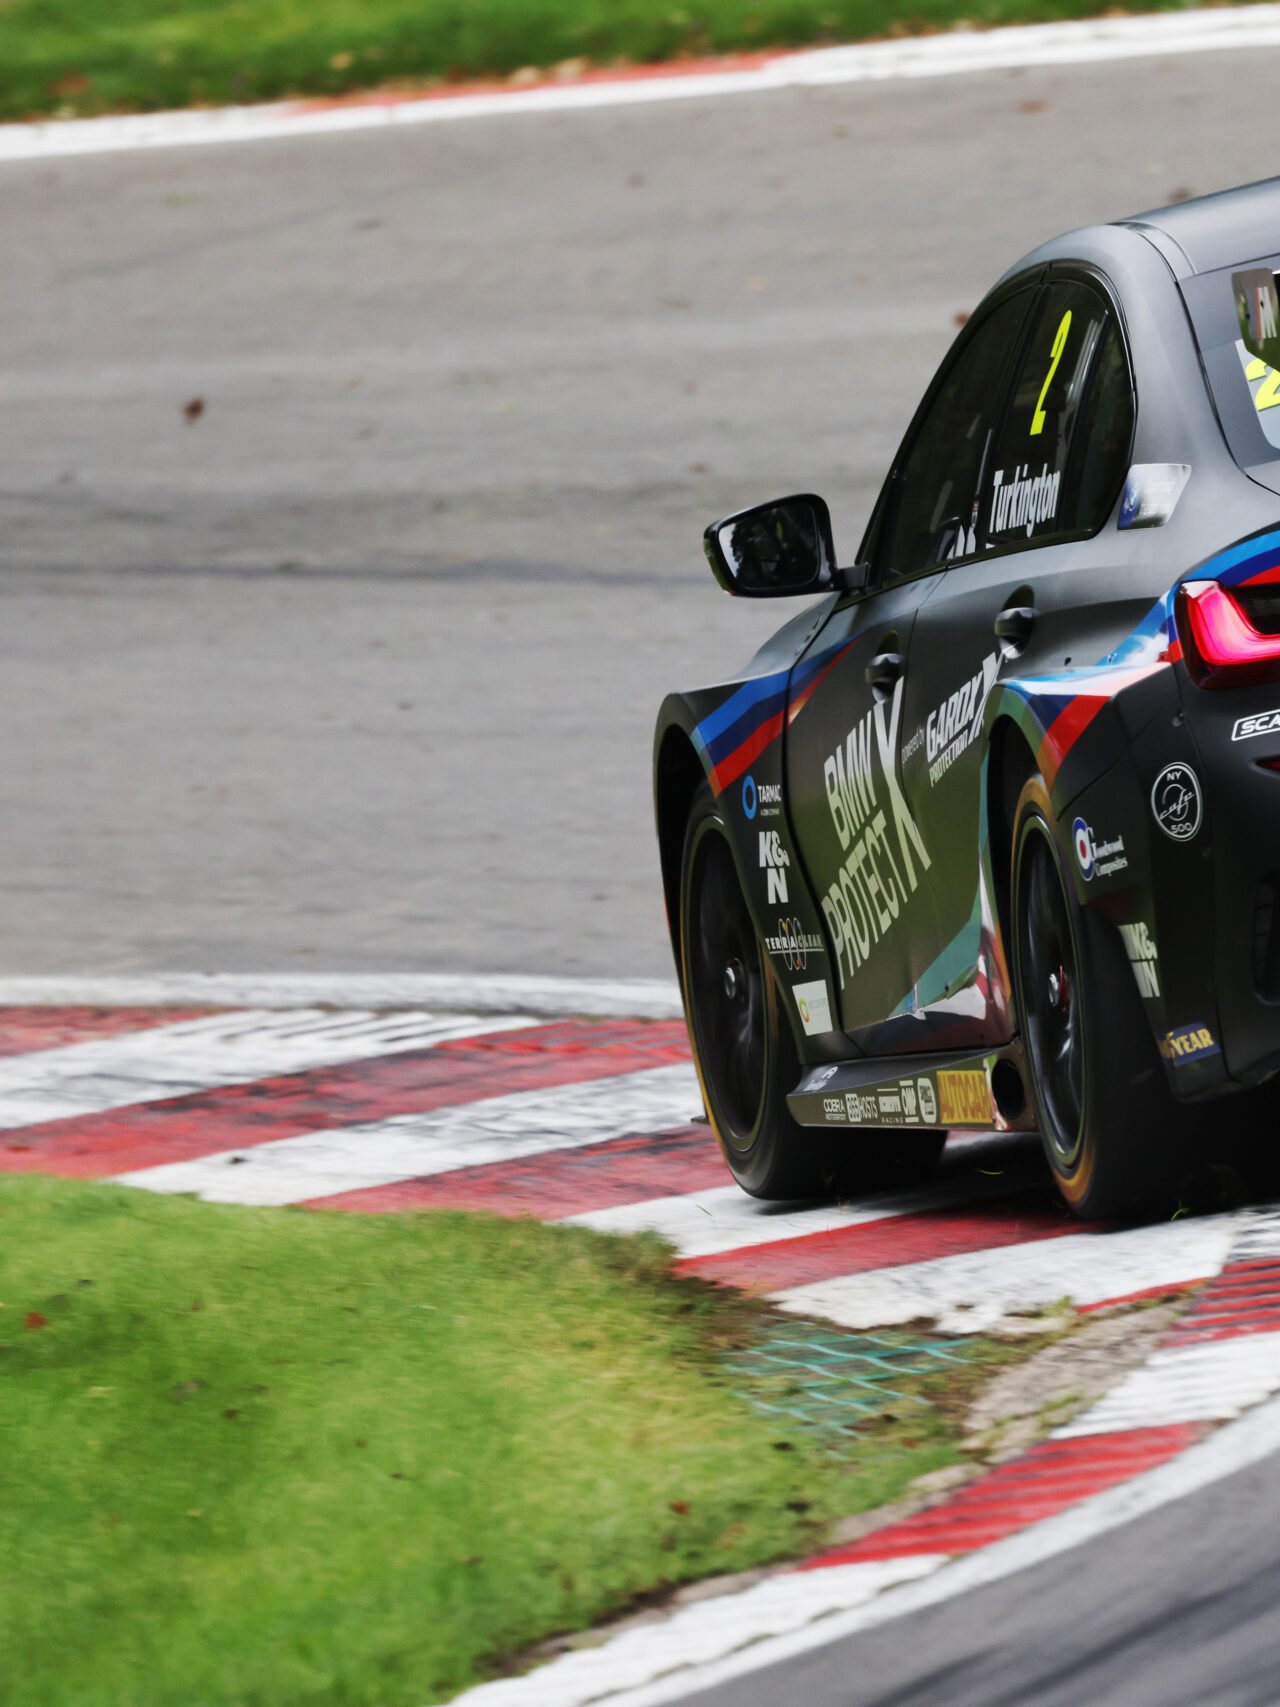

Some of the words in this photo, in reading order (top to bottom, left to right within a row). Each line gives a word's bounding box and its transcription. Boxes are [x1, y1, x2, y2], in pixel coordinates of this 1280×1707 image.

[1030, 310, 1073, 436] 2
[989, 462, 1061, 539] Turkington
[823, 710, 877, 851] BMW
[1166, 770, 1183, 782] NY
[1170, 822, 1193, 835] 500
[821, 808, 909, 991] PROTECT
